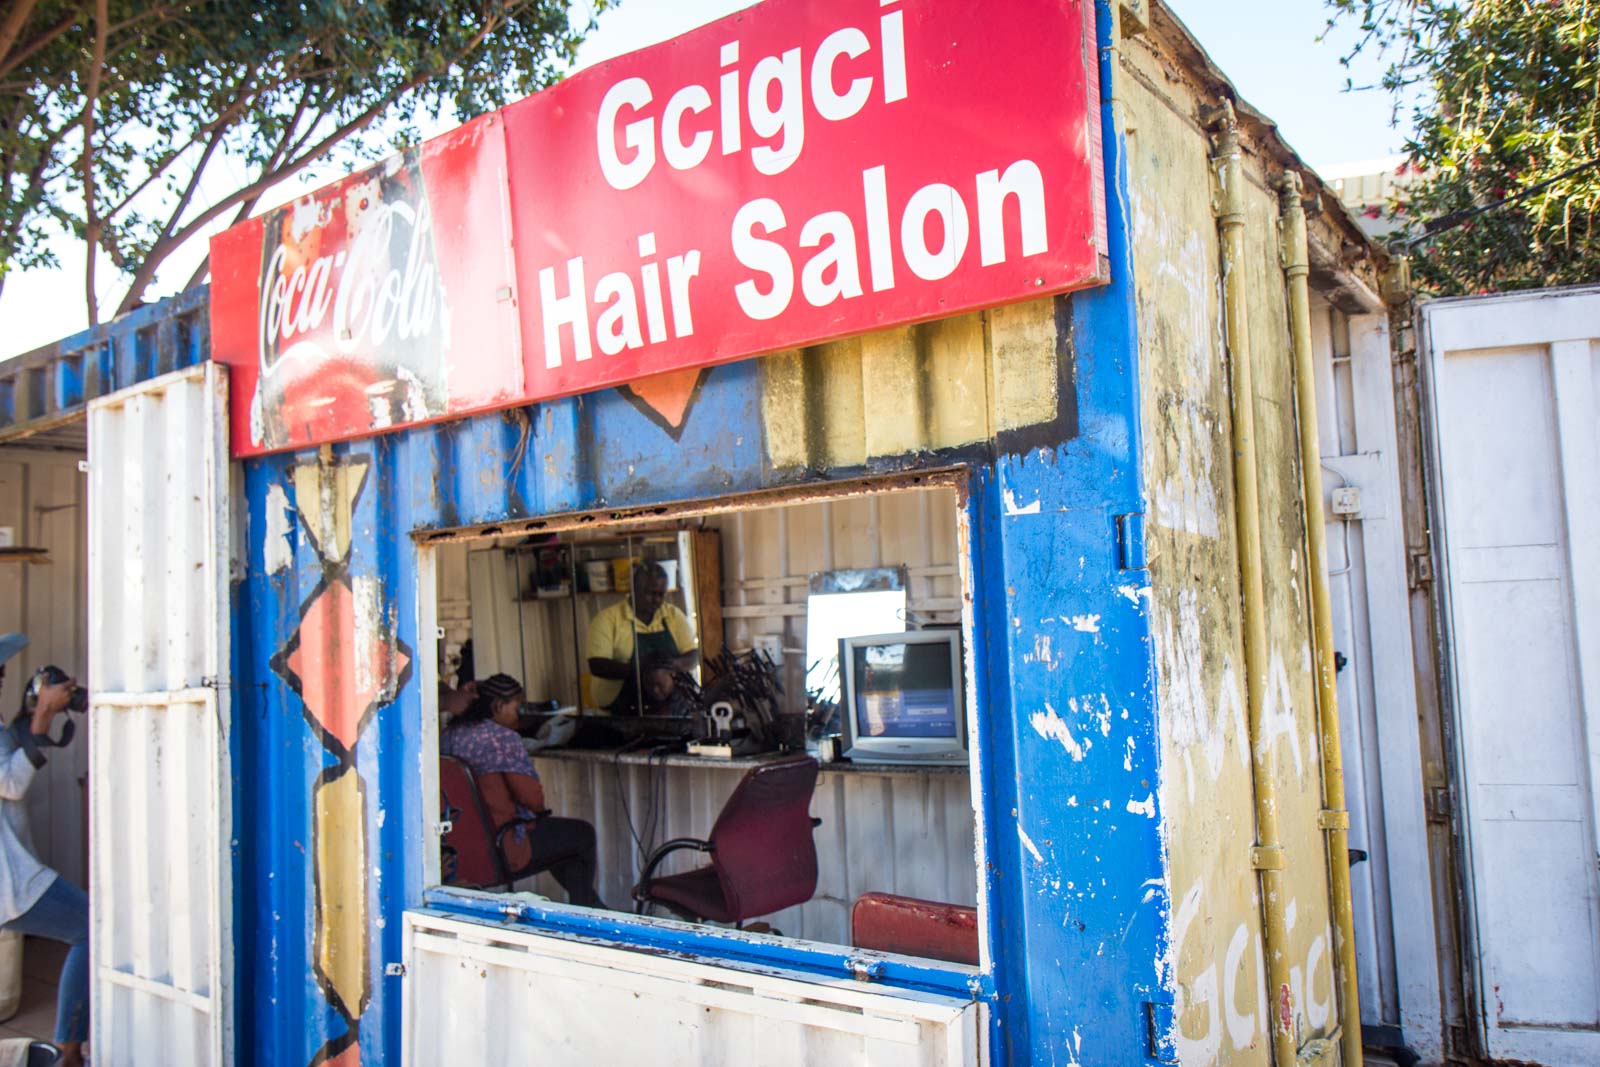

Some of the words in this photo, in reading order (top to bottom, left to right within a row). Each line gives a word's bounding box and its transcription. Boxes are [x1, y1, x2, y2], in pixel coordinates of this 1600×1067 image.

[597, 0, 908, 190] Gcigci
[538, 231, 701, 369] Hair
[731, 159, 1048, 320] Salon
